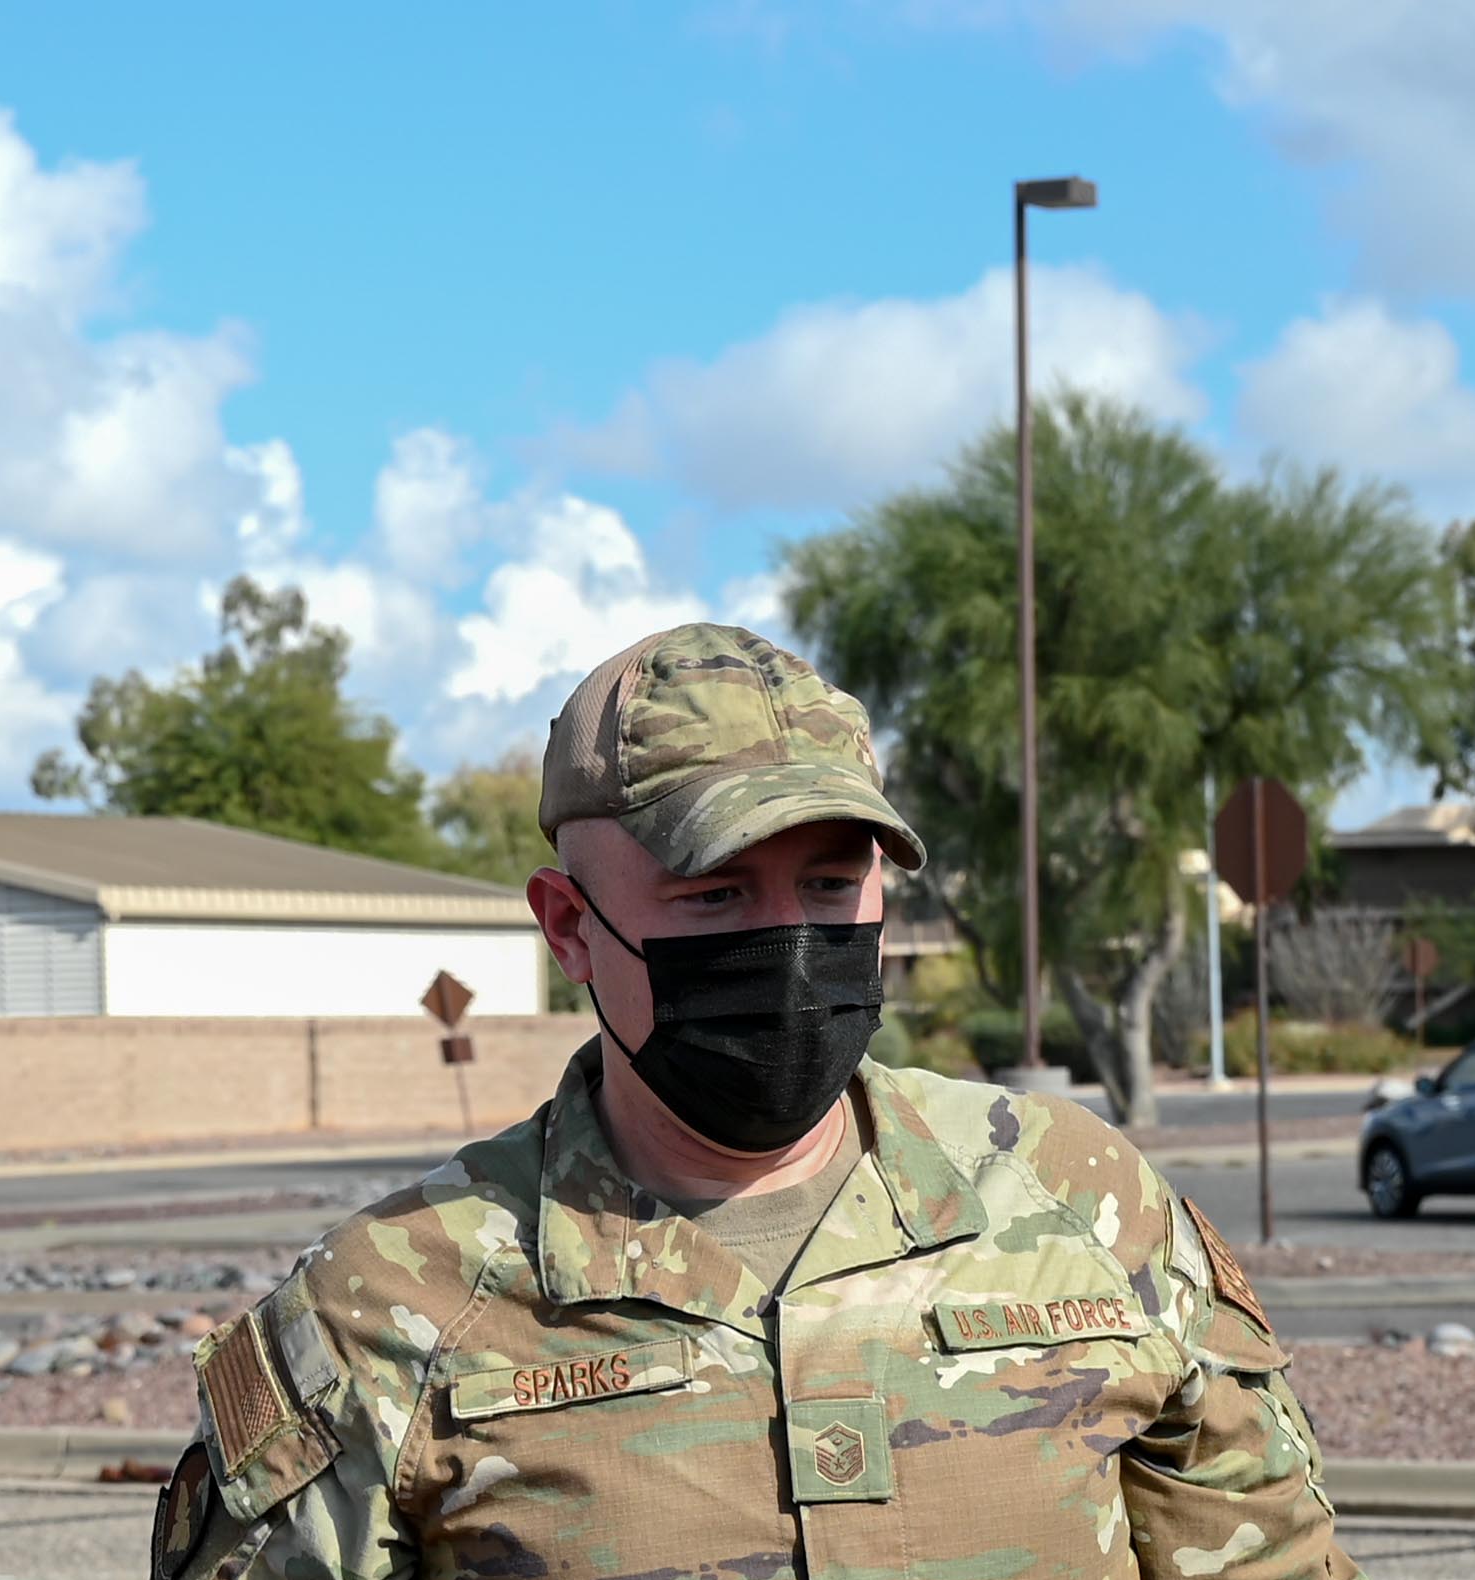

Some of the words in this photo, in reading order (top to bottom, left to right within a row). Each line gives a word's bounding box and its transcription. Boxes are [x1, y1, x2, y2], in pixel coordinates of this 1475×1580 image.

[952, 1308, 1003, 1341] U.S.
[1002, 1303, 1044, 1337] AIR
[1045, 1297, 1132, 1335] FORCE
[513, 1353, 630, 1406] SPARKS
